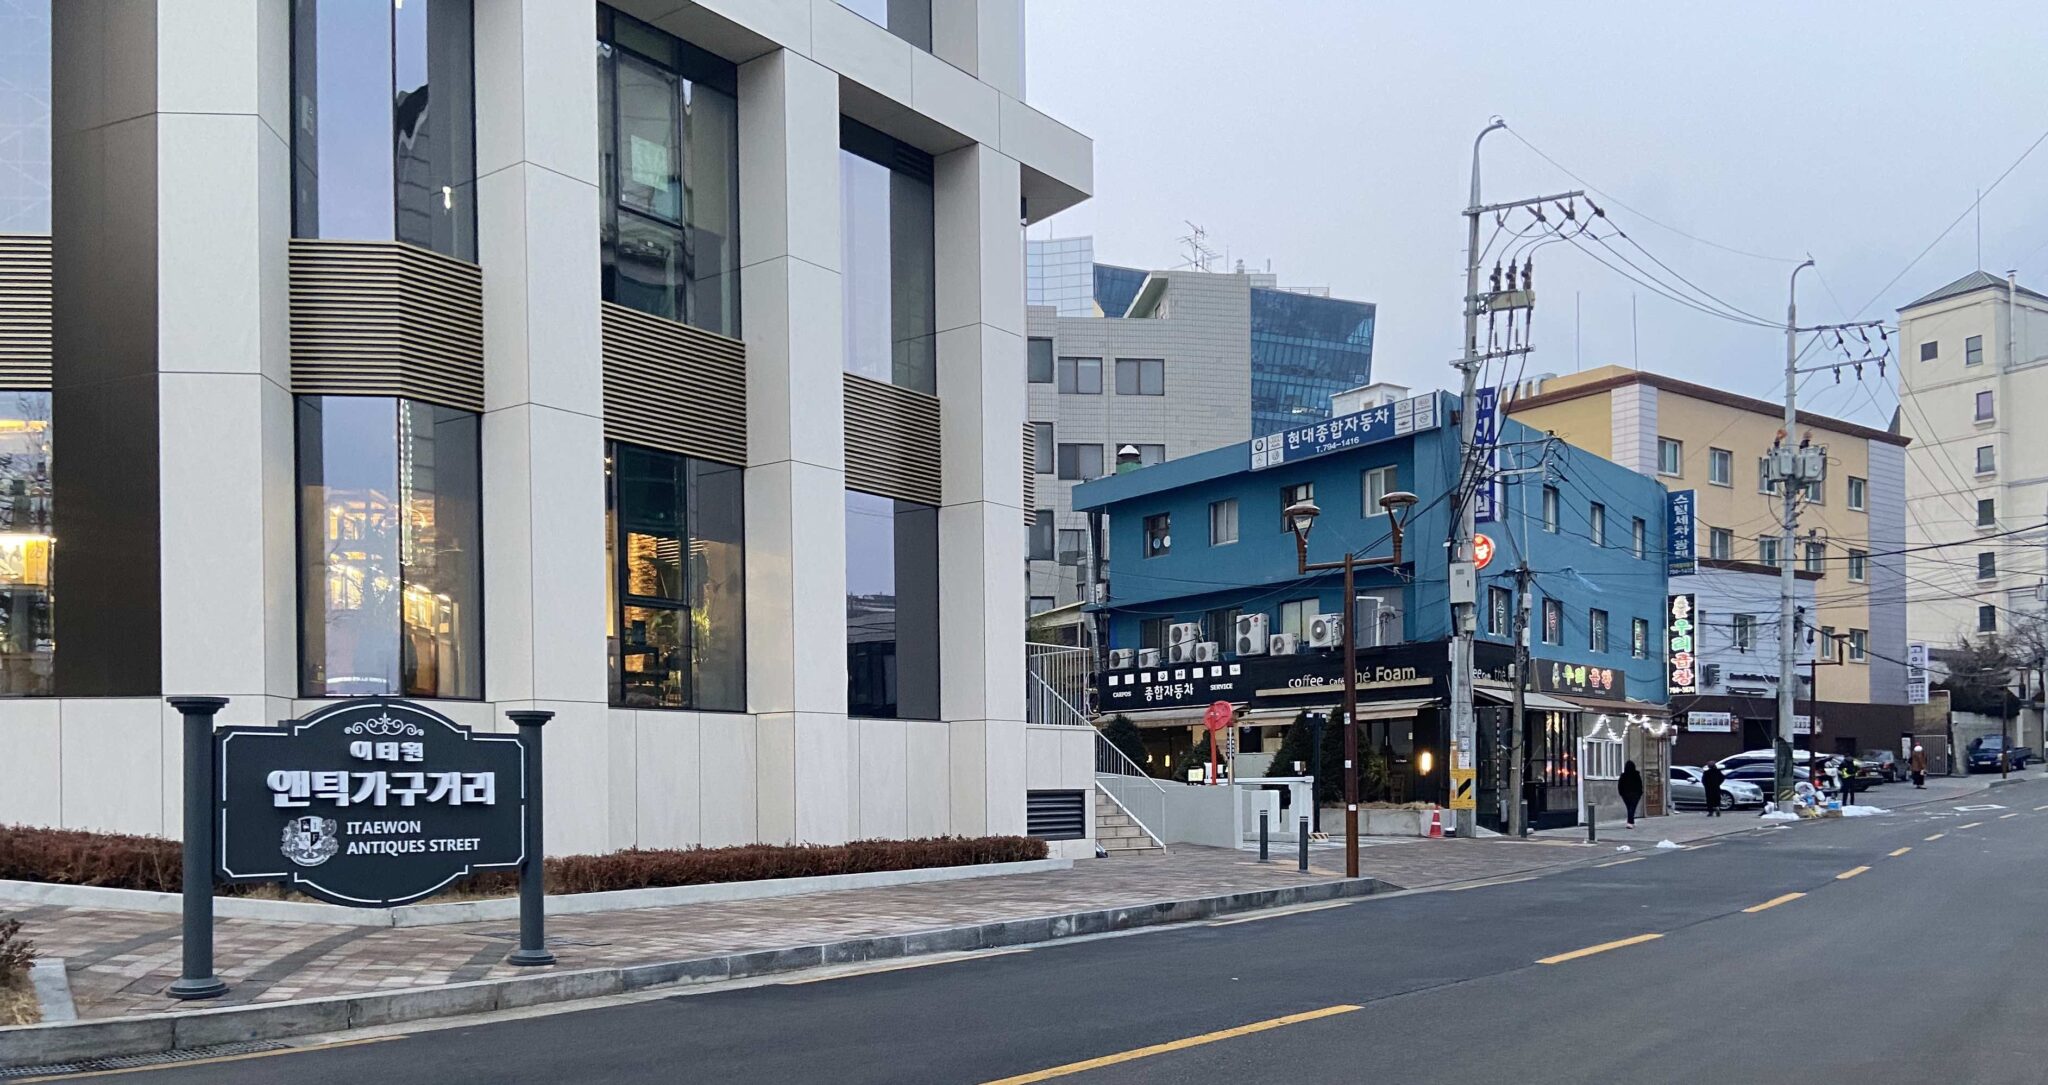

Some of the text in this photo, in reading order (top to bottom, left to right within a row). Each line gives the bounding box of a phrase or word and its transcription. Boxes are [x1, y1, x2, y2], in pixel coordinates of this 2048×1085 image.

[1287, 408, 1389, 450] 현대종합자동차
[1315, 436, 1360, 454] T.794-1416
[1210, 683, 1233, 691] SERVICE
[1288, 674, 1324, 688] coffee
[1354, 666, 1371, 683] hé
[1375, 666, 1416, 682] Foam
[1144, 682, 1194, 702] 종합자동차
[350, 741, 424, 762] 이태원
[266, 770, 495, 808] 앤틱가구거리
[347, 820, 421, 835] ITAEWON
[346, 838, 481, 857] ANTIQUES STREET
